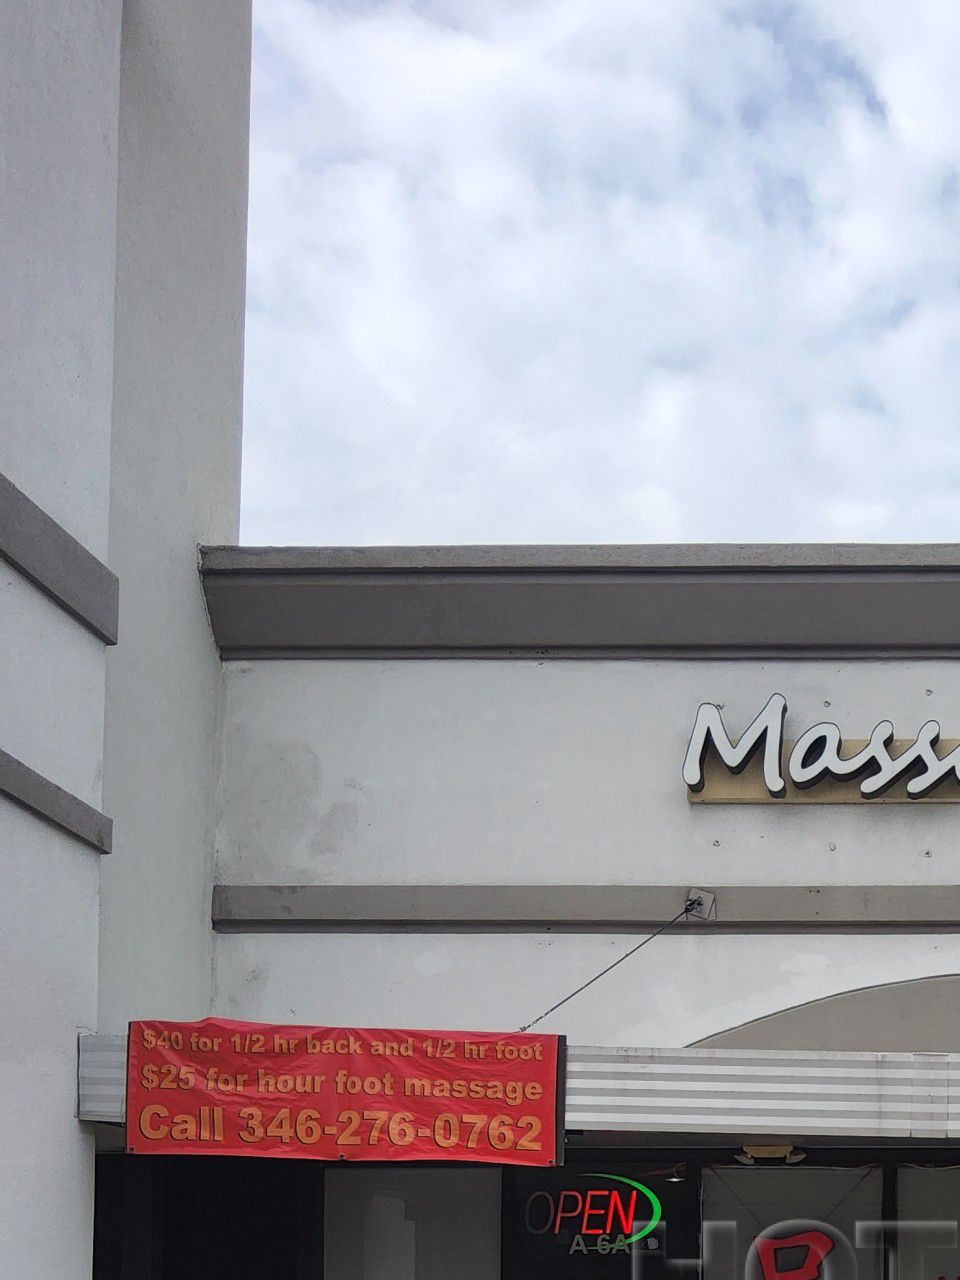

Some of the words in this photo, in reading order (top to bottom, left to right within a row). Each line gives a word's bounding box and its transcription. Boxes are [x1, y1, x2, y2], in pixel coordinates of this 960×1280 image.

[143, 1029, 183, 1050] $40
[190, 1032, 222, 1052] for
[231, 1034, 265, 1053] 1/2
[273, 1034, 298, 1054] hr
[306, 1035, 363, 1055] back
[370, 1038, 414, 1057] and
[422, 1038, 456, 1058] 1/2
[464, 1040, 488, 1059] hr
[495, 1040, 544, 1061] foot
[141, 1063, 196, 1091] $25
[205, 1067, 249, 1092] for
[257, 1069, 326, 1094] hour
[335, 1070, 394, 1096] foot
[404, 1076, 543, 1106] massage
[139, 1104, 224, 1141] Call
[238, 1107, 542, 1151] 346-276-0762
[524, 1190, 637, 1235] OPEN
